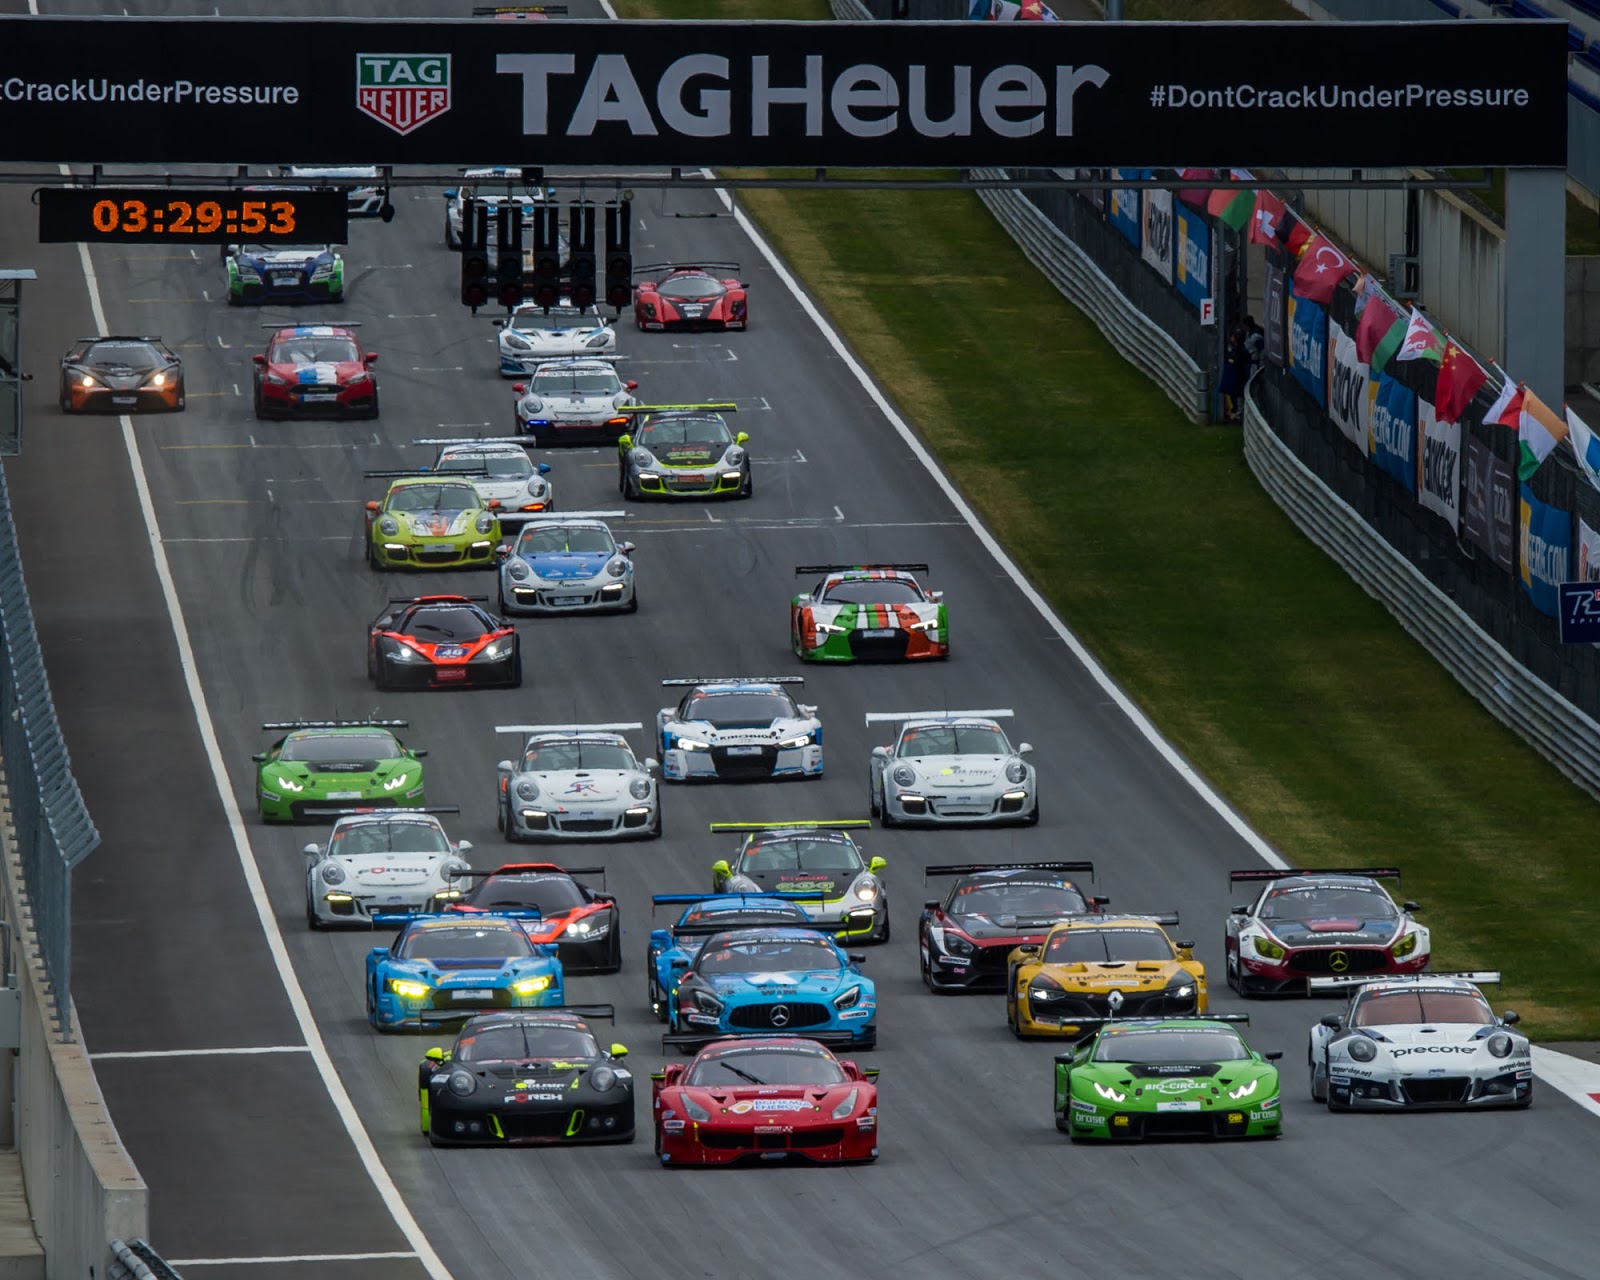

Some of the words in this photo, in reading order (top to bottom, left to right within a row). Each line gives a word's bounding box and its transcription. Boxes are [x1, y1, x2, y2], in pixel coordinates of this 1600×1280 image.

[364, 60, 442, 83] TAG
[0, 78, 298, 103] CrackUnderPressure
[1151, 85, 1528, 107] #DontCrackUnderPressure
[362, 90, 445, 127] HEUER
[93, 200, 295, 233] 03:29:53
[1204, 303, 1212, 320] F
[1391, 1045, 1474, 1058] precote
[1075, 1111, 1105, 1124] brose
